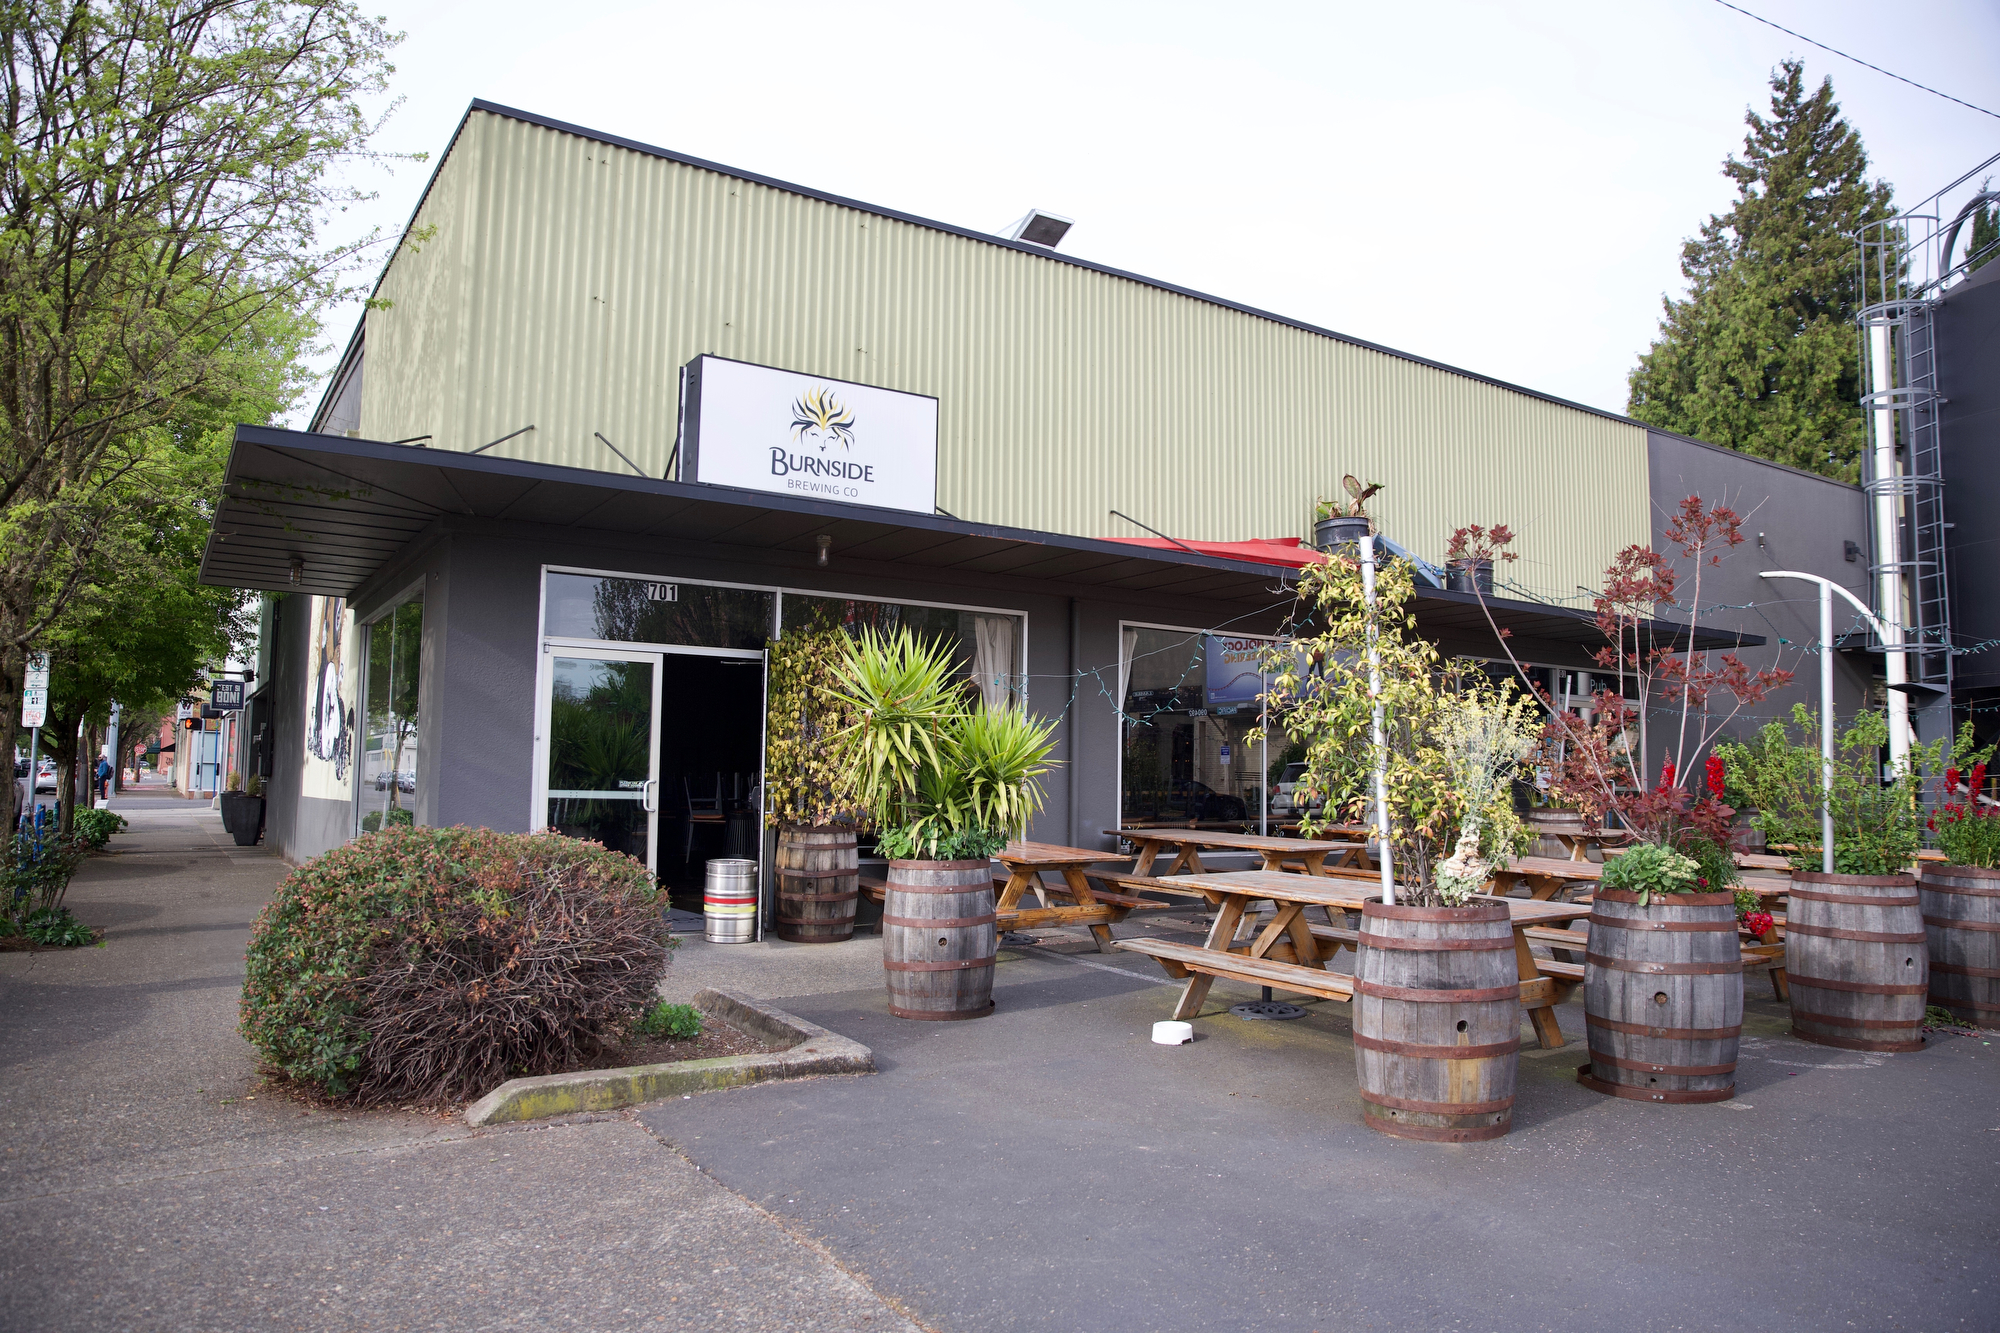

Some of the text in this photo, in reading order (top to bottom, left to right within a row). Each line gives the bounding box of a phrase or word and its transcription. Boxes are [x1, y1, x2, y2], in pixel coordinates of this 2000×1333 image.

[787, 479, 859, 497] BREWING CO
[650, 583, 676, 600] 701
[1590, 679, 1607, 692] Pub
[216, 691, 240, 704] BON!
